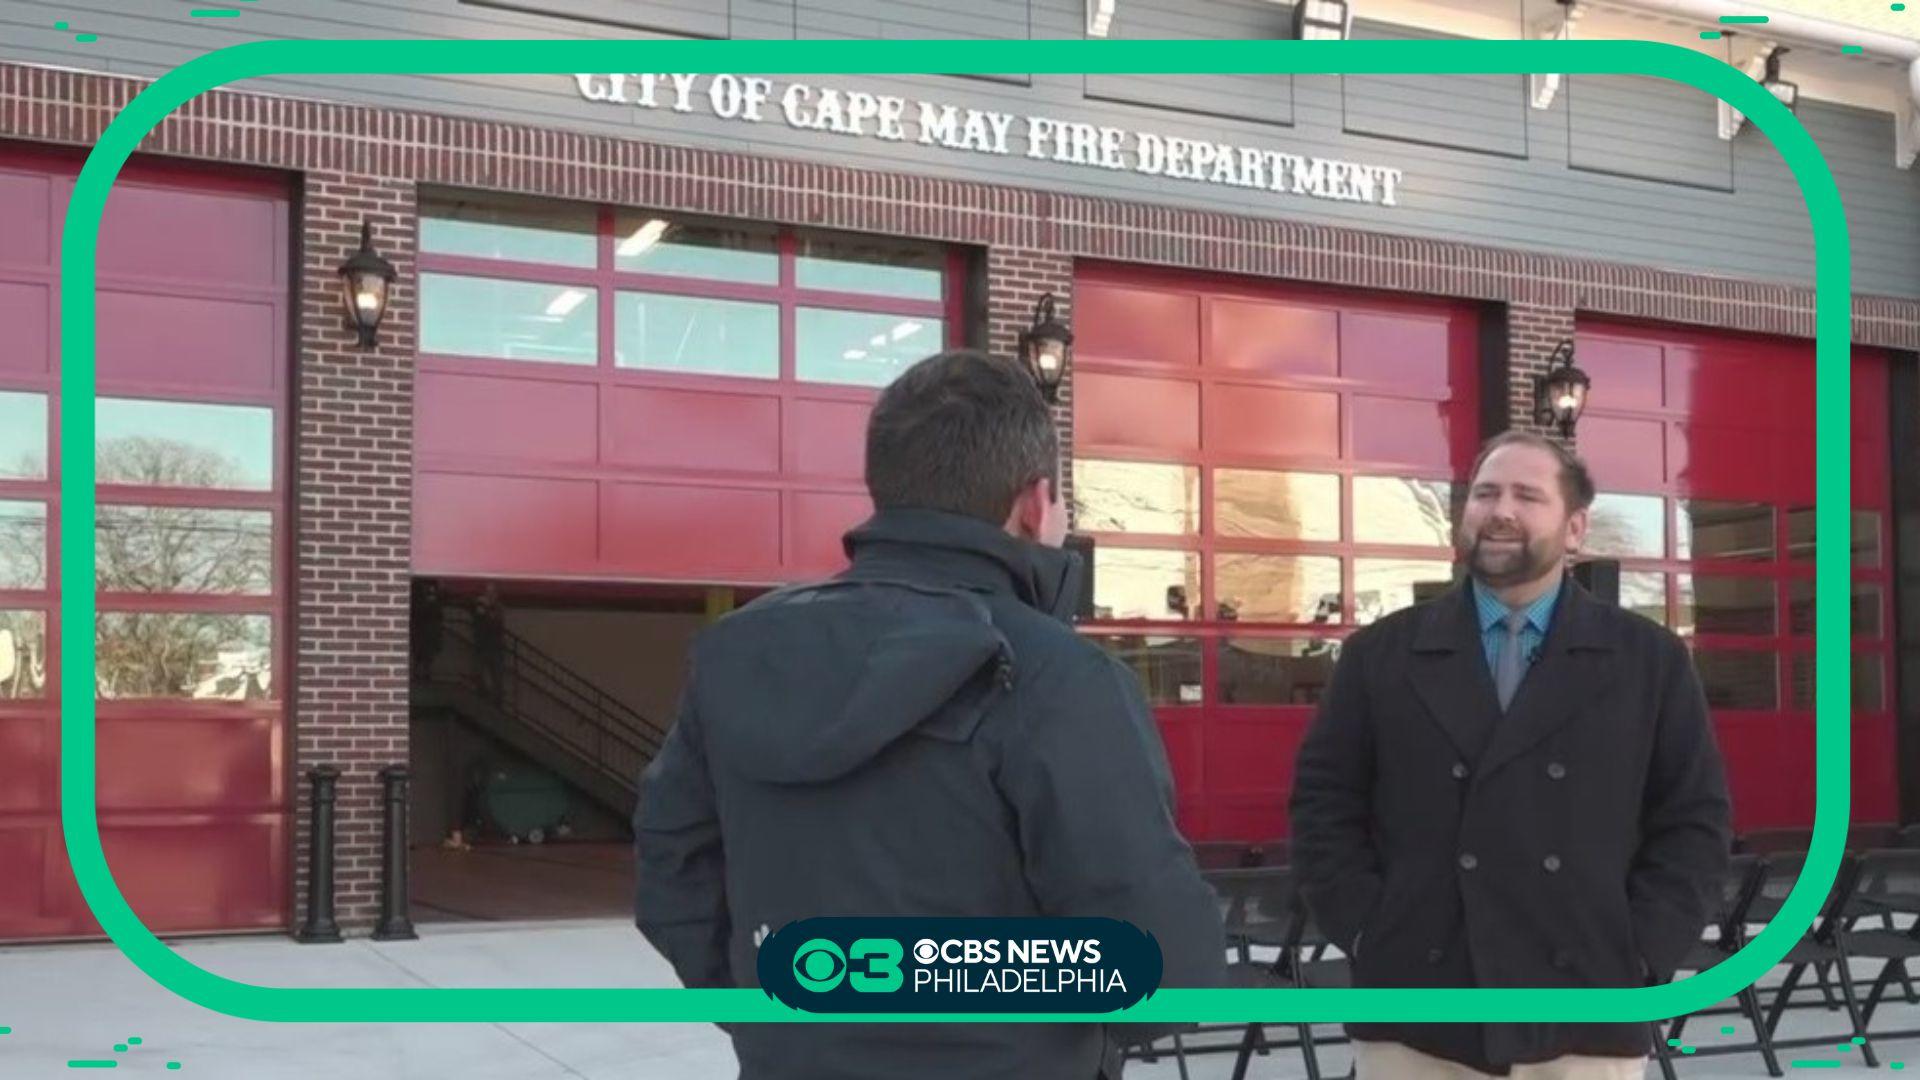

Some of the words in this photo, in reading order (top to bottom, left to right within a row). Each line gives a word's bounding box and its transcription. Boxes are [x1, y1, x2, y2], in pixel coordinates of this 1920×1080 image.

[575, 73, 698, 112] CITY
[708, 73, 773, 122] OF
[781, 83, 911, 140] CAPE
[917, 100, 1014, 154] MAY
[1026, 115, 1127, 169] FIRE
[1135, 130, 1403, 206] DEPARTMENT
